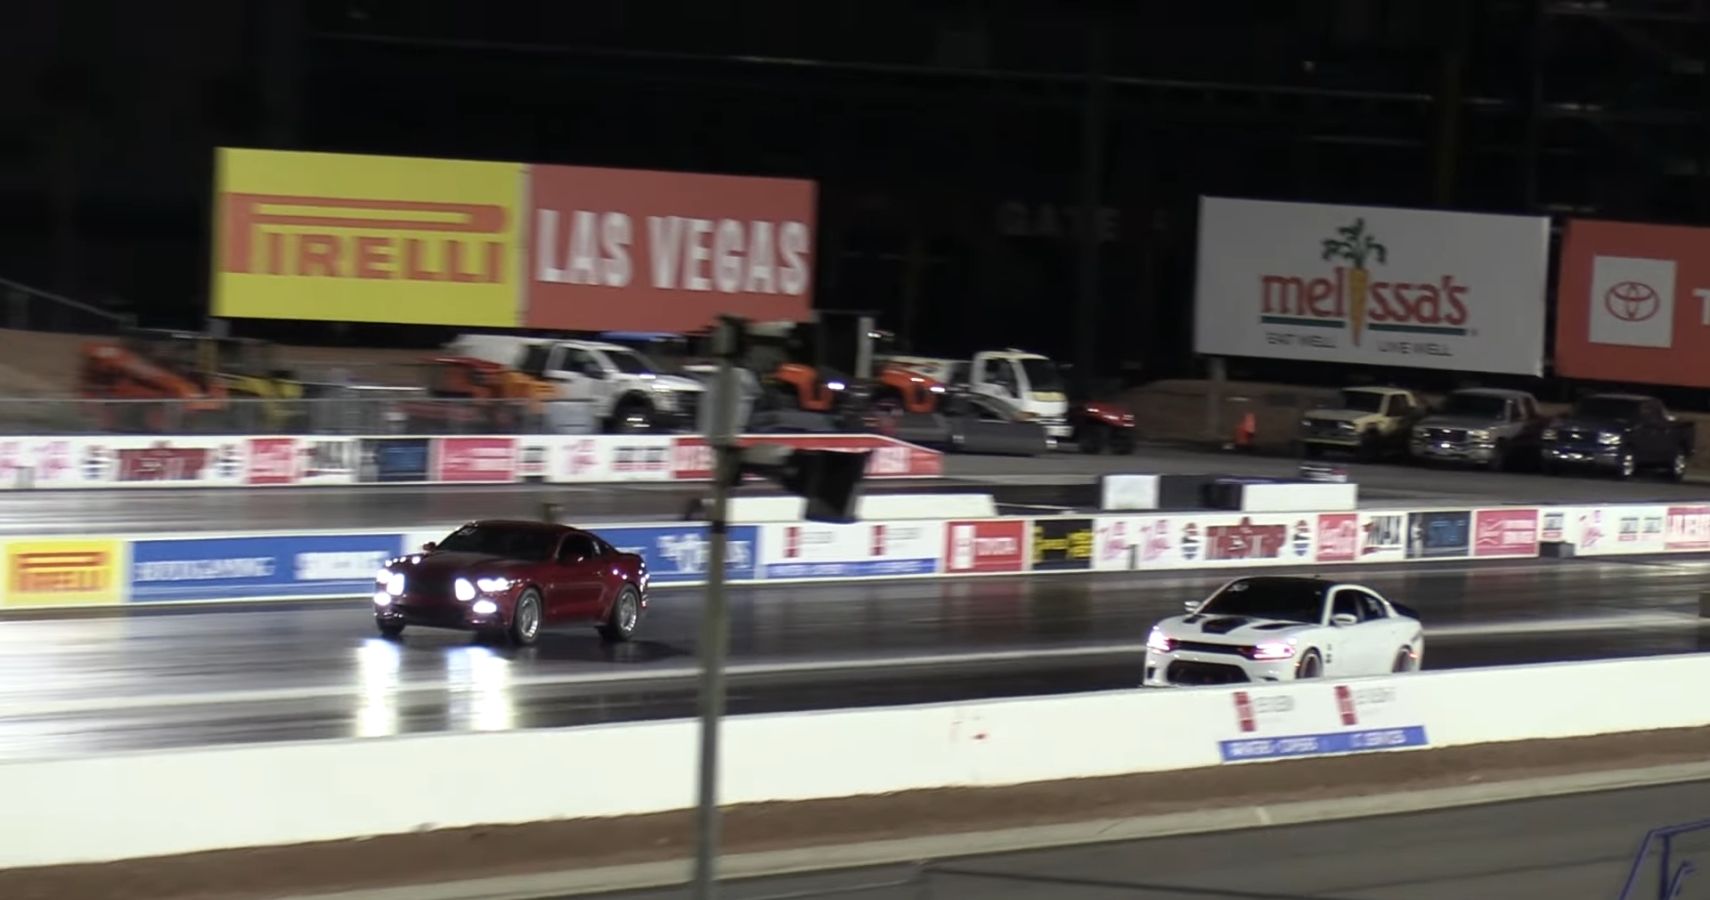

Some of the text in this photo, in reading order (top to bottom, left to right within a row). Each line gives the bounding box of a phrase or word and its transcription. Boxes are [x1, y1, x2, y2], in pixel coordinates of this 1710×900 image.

[220, 192, 507, 284] PIRELLI
[535, 208, 810, 296] LAS VEGAS
